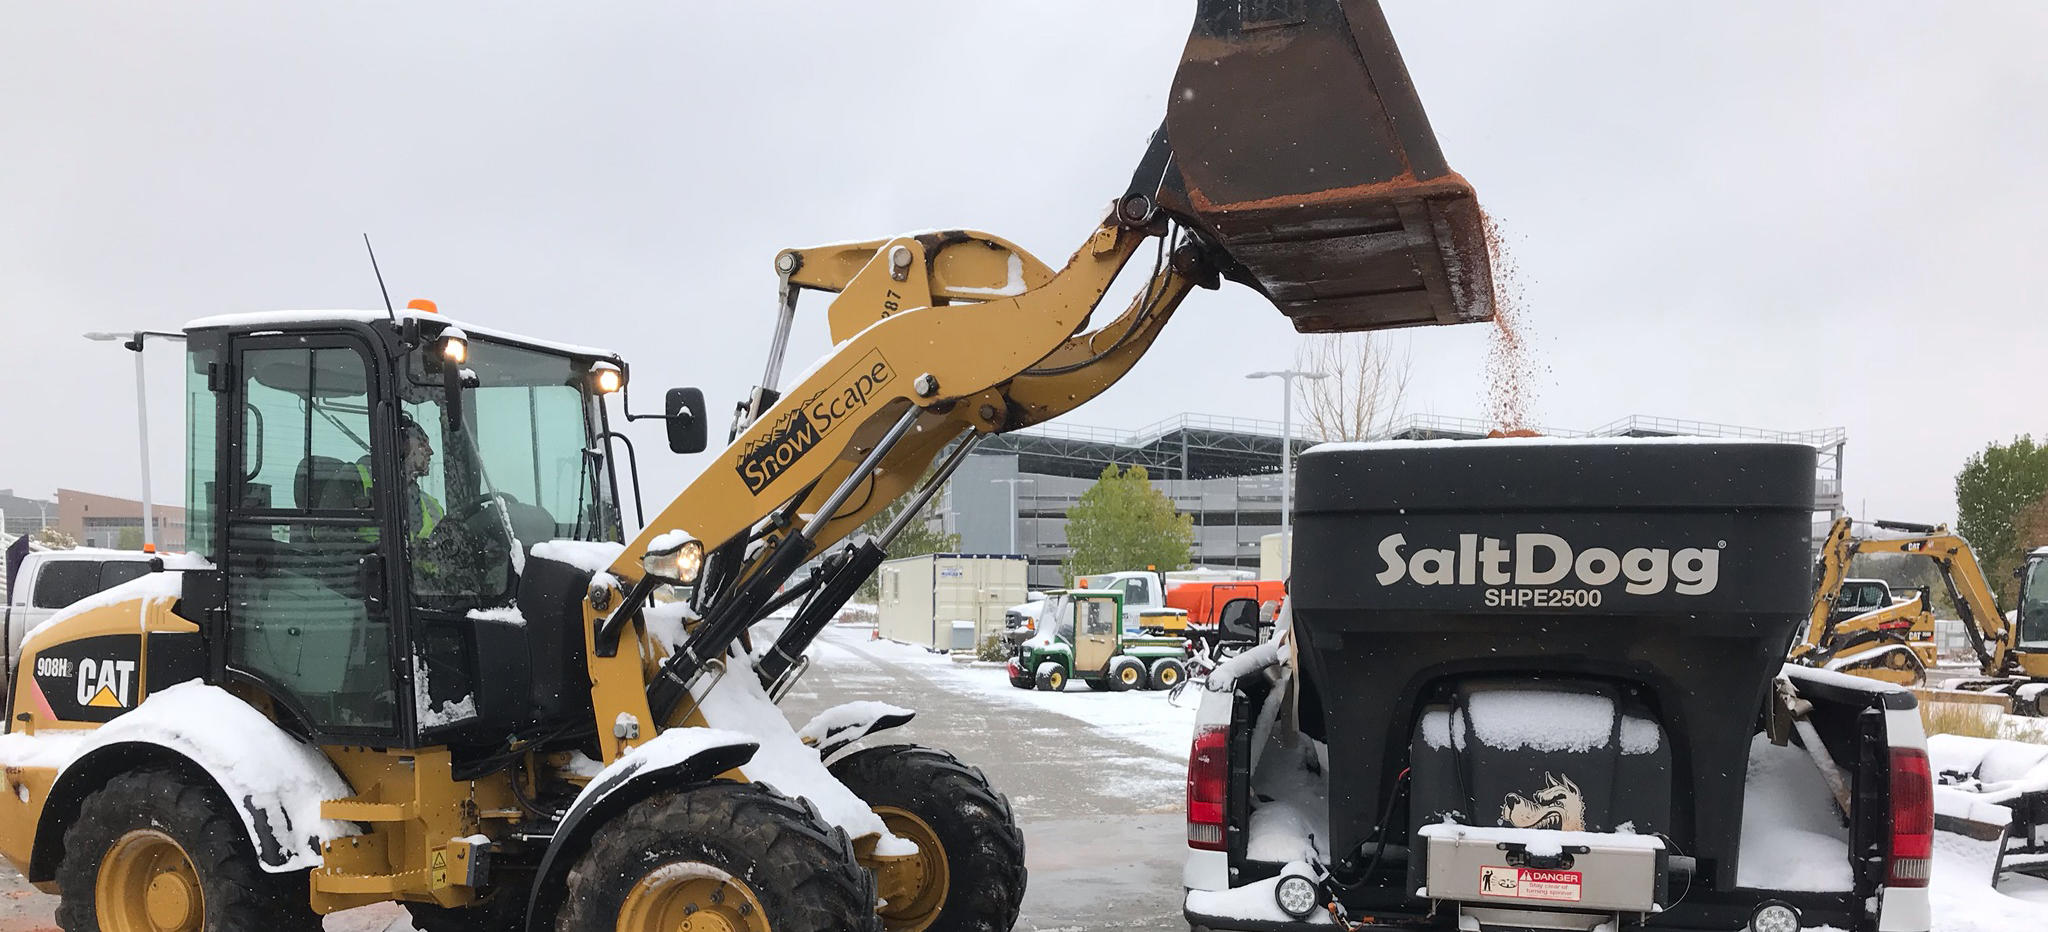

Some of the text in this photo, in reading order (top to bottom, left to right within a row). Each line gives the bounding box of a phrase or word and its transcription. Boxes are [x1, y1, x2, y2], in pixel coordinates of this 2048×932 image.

[1908, 542, 1921, 551] CAT
[1484, 588, 1602, 607] SHPE2500
[1908, 631, 1921, 640] CAT
[77, 657, 135, 708] CAT
[1533, 872, 1578, 883] DANGER
